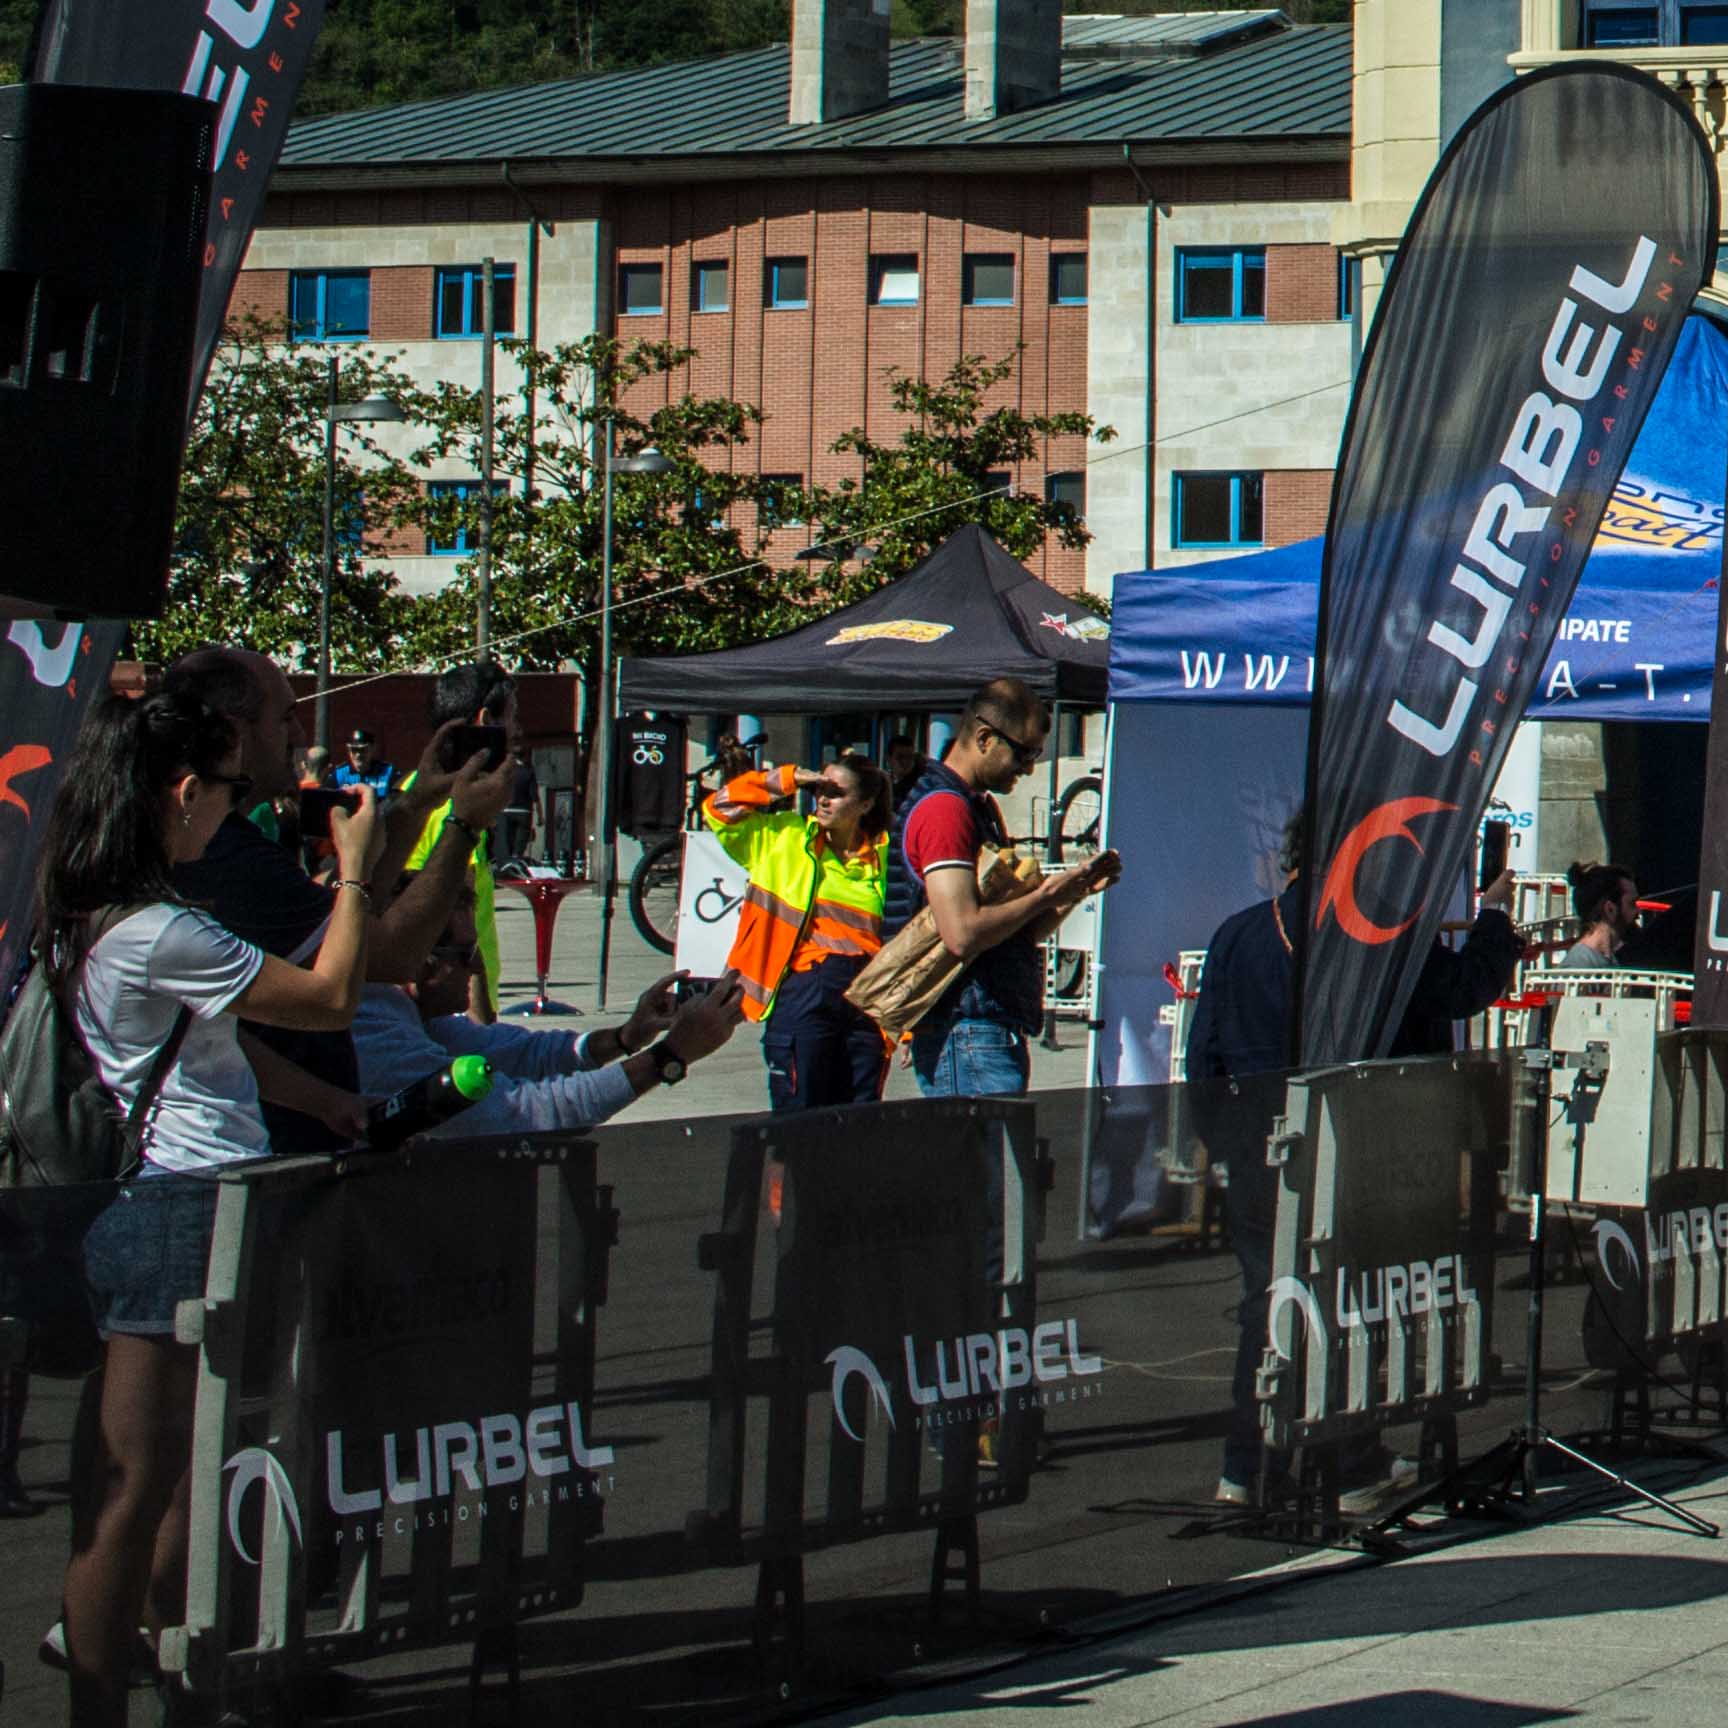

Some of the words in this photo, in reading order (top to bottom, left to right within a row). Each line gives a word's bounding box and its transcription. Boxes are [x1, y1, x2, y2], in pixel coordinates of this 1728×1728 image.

[1388, 235, 1657, 756] LURBEL
[1470, 507, 1577, 766] PRECISION
[1588, 252, 1685, 466] GARMENT
[1336, 1253, 1476, 1329] LURBEL
[905, 1319, 1104, 1405] LURBEL
[915, 1400, 1007, 1430] PRECISION
[1018, 1381, 1105, 1413] GARMENT
[327, 1402, 614, 1515] LURBEL
[336, 1500, 488, 1544] PRECISION
[509, 1475, 617, 1513] GARMENT
